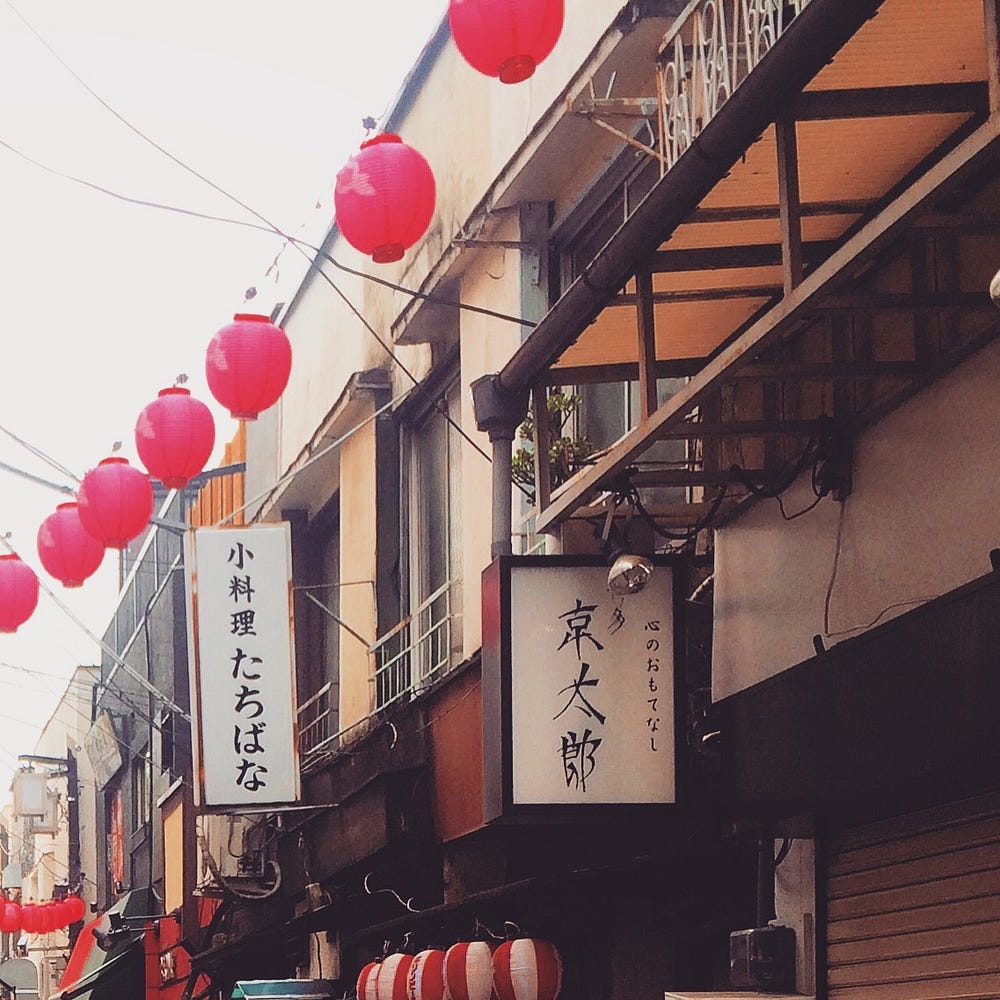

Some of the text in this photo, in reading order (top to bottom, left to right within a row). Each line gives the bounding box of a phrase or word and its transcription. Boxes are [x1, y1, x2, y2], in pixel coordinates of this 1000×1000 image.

[227, 541, 269, 792] 小料理 たちばな
[553, 598, 606, 793] 京太郎
[644, 619, 661, 752] 心のおもてなし
